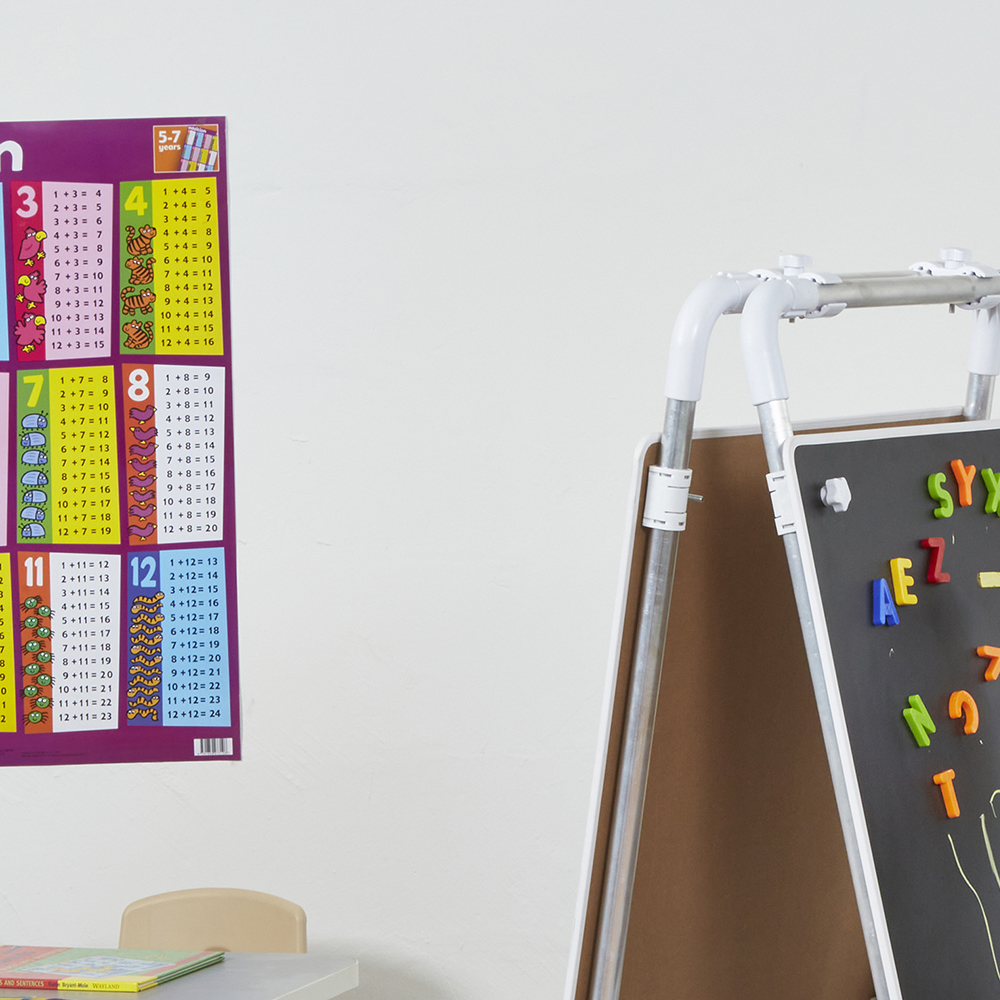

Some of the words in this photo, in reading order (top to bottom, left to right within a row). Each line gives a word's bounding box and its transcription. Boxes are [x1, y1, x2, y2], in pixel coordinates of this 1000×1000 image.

[158, 130, 181, 144] 5-7
[158, 144, 182, 153] years
[16, 185, 38, 218] 3
[124, 186, 148, 216] 4
[51, 313, 62, 323] 10
[75, 313, 80, 322] 3
[93, 312, 105, 322] 13
[161, 311, 172, 320] 10
[184, 311, 190, 319] 4
[203, 310, 214, 318] 14
[51, 341, 63, 350] 12
[75, 340, 80, 350] 3
[94, 340, 105, 349] 15
[161, 338, 172, 347] 12
[184, 338, 191, 347] 4
[204, 338, 215, 346] 16
[128, 368, 150, 402] 8
[23, 374, 44, 408] 7
[58, 500, 69, 509] 10
[81, 500, 87, 508] 7
[100, 499, 111, 508] 17
[163, 497, 174, 506] 10
[186, 497, 193, 506] 8
[205, 496, 217, 505] 18
[58, 527, 69, 536] 12
[82, 528, 87, 536] 7
[100, 527, 112, 536] 19
[163, 525, 174, 533] 12
[186, 524, 193, 533] 8
[205, 523, 218, 533] 20
[24, 557, 44, 587] 11
[130, 556, 157, 588] 12
[16, 980, 45, 988] SENTENCES
